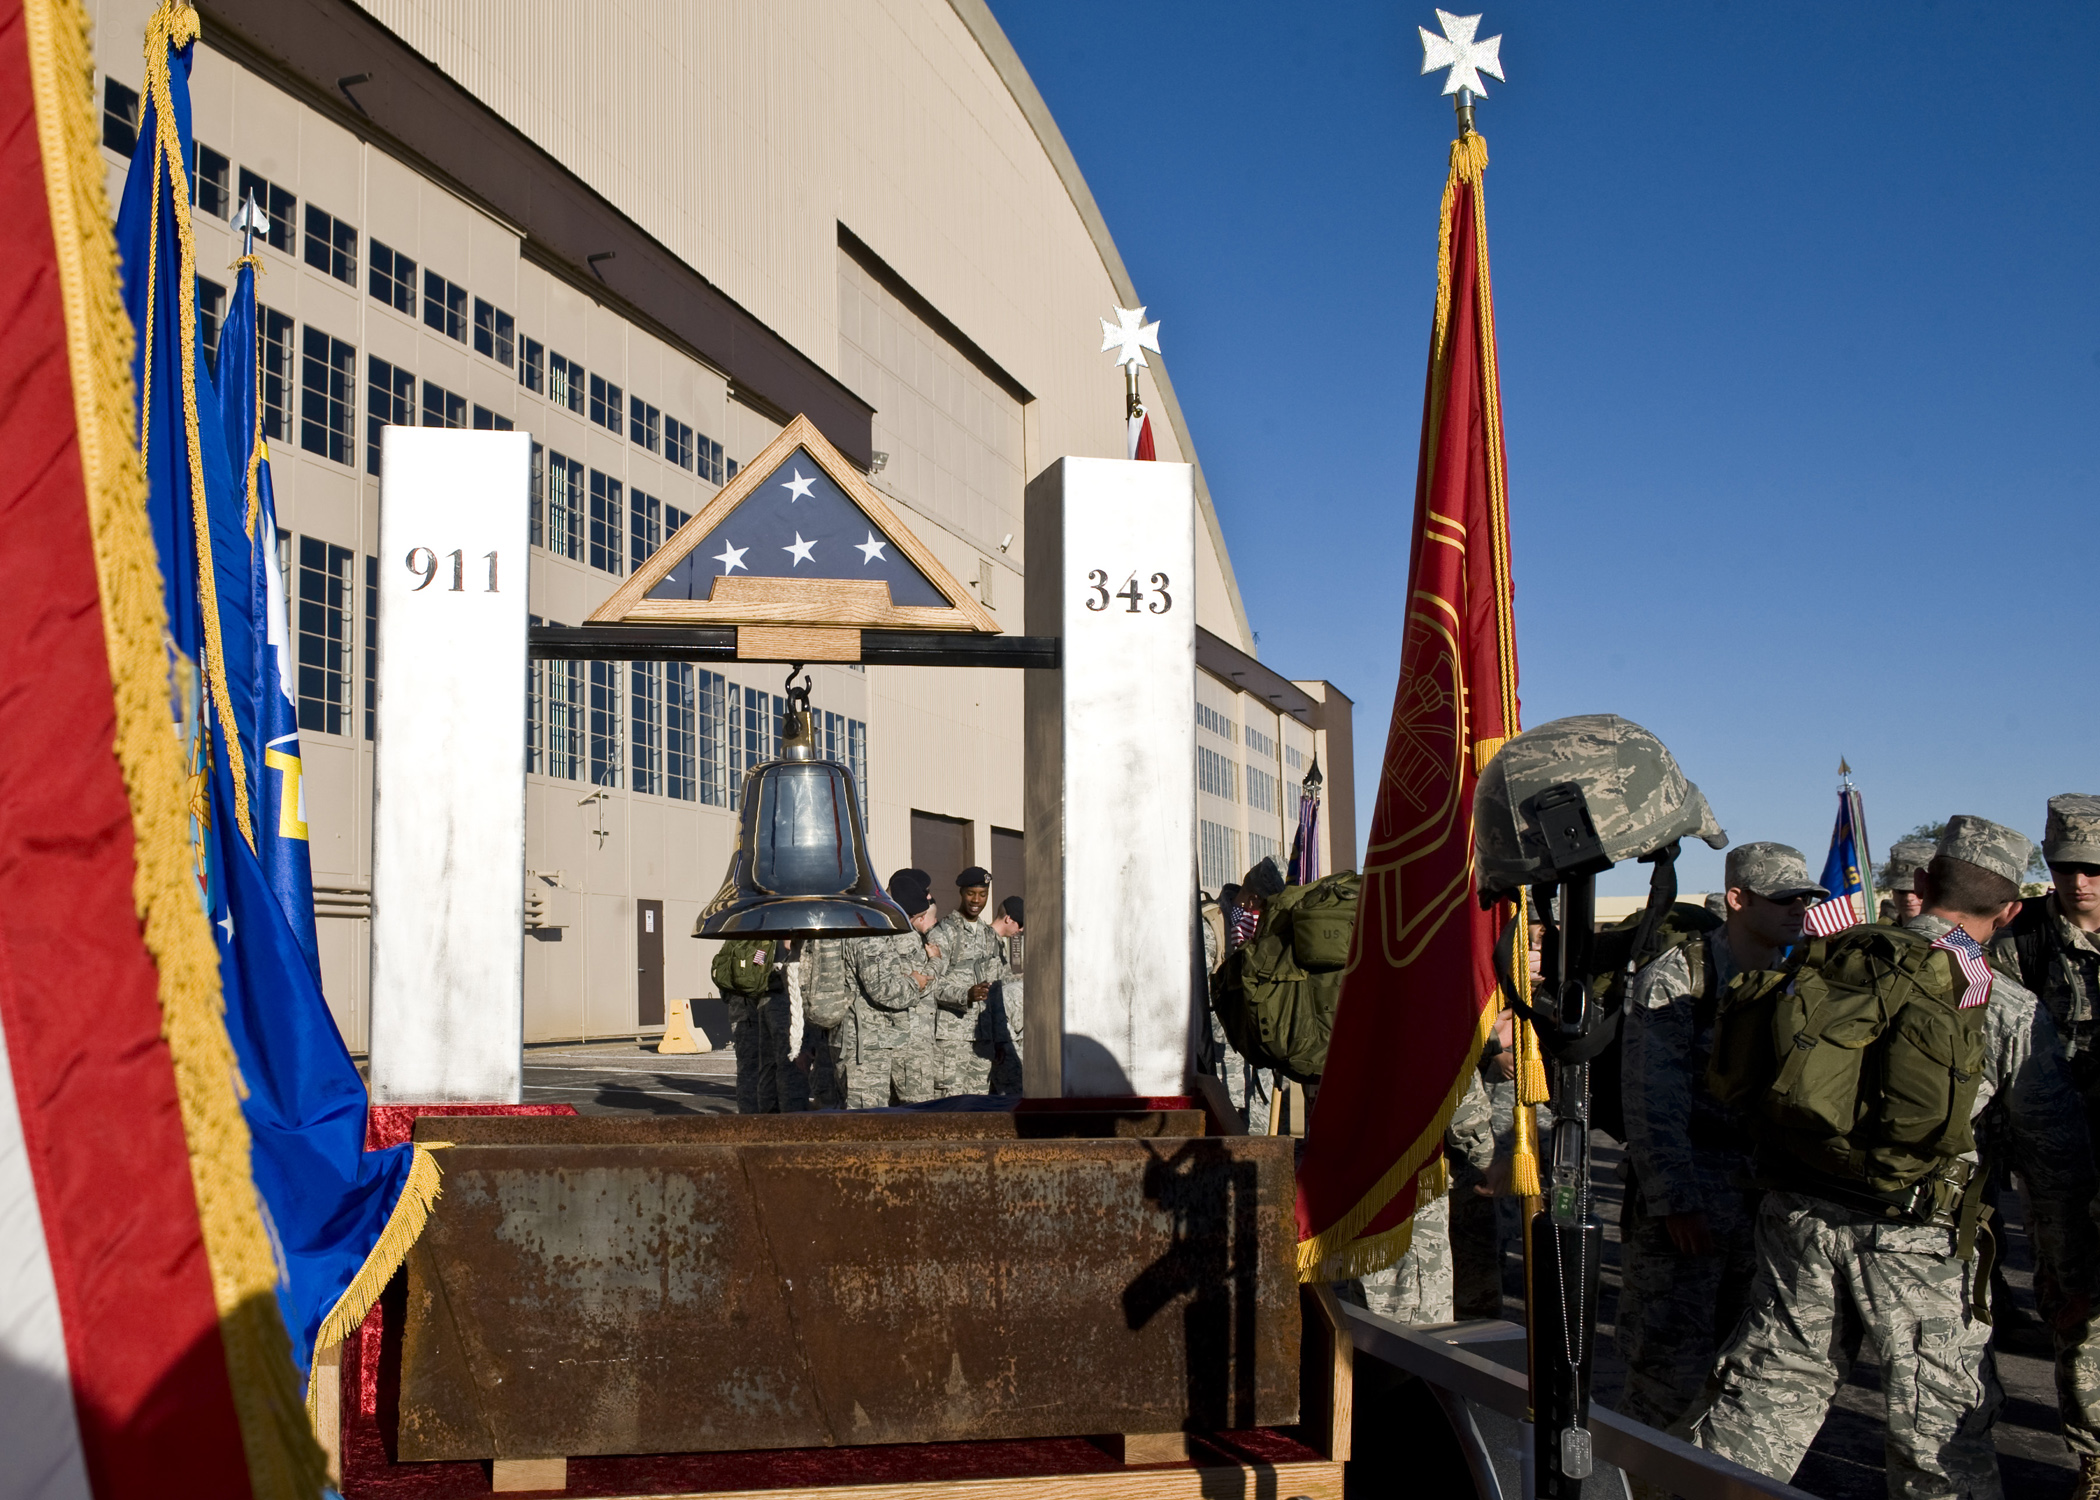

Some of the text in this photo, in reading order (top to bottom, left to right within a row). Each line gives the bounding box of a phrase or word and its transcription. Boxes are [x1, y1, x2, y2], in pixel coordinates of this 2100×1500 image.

[405, 546, 500, 592] 911
[1085, 569, 1172, 614] 343
[1323, 929, 1340, 940] US
